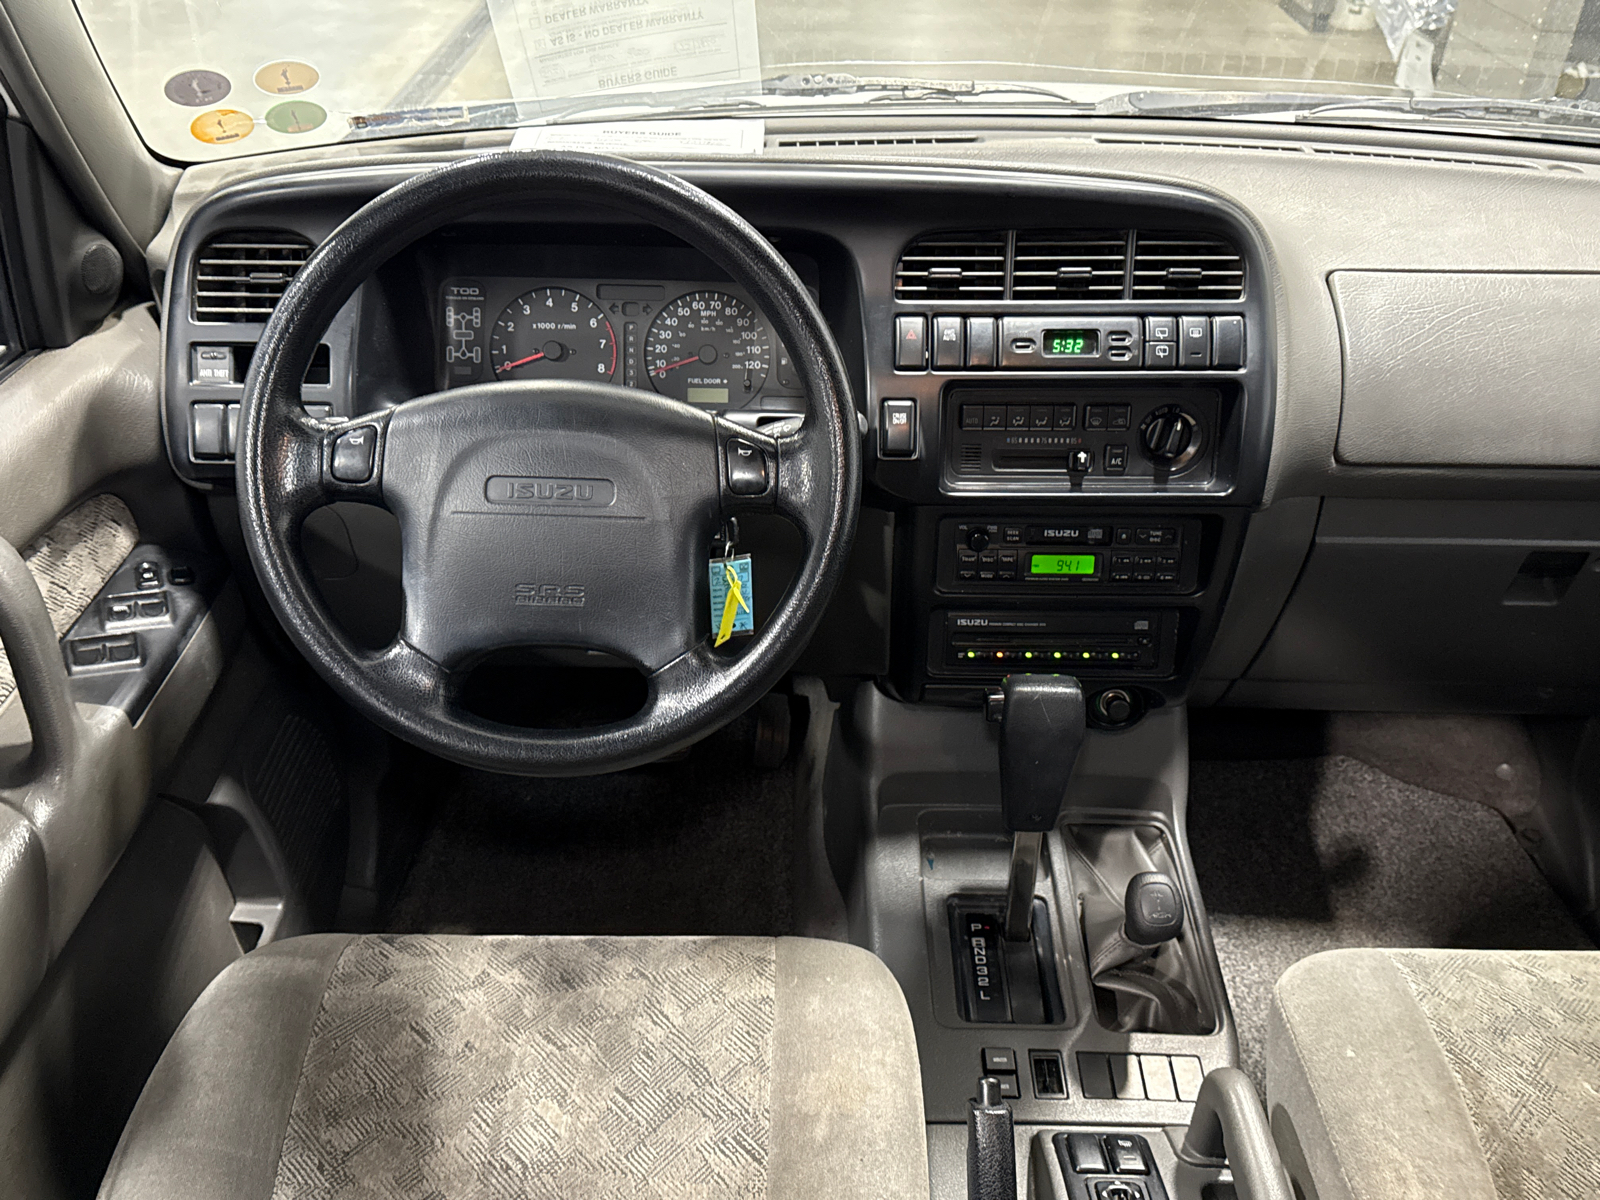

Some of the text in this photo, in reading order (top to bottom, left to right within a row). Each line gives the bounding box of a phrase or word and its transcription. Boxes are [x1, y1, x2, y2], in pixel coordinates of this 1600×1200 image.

[450, 286, 479, 295] TOD
[545, 298, 553, 307] 4
[571, 302, 579, 312] 5
[692, 301, 705, 310] 60
[709, 301, 722, 310] 70
[522, 304, 531, 315] 3
[677, 307, 690, 316] 50
[725, 307, 738, 316] 80
[532, 322, 556, 330] x1000
[590, 318, 597, 328] 6
[665, 317, 678, 326] 40
[737, 318, 750, 327] 90
[507, 321, 515, 332] 2
[659, 330, 672, 339] 30
[741, 331, 758, 340] 100
[599, 339, 606, 349] 7
[1052, 339, 1084, 353] 5:32
[502, 345, 507, 354] 1
[655, 344, 667, 354] 20
[746, 346, 761, 354] 110
[597, 363, 605, 374] 8
[656, 360, 666, 368] 10
[744, 361, 761, 370] 120
[199, 368, 230, 378] ANTI THEFT
[1111, 457, 1123, 465] A/C
[507, 482, 594, 501] ISUZU
[1043, 529, 1080, 538] ISUZU
[515, 583, 585, 597] SRS
[956, 618, 989, 626] ISUZU
[970, 923, 982, 932] P
[973, 947, 986, 956] N
[975, 955, 987, 965] D
[976, 966, 988, 975] 3
[977, 976, 990, 987] 2
[979, 990, 991, 1000] L
